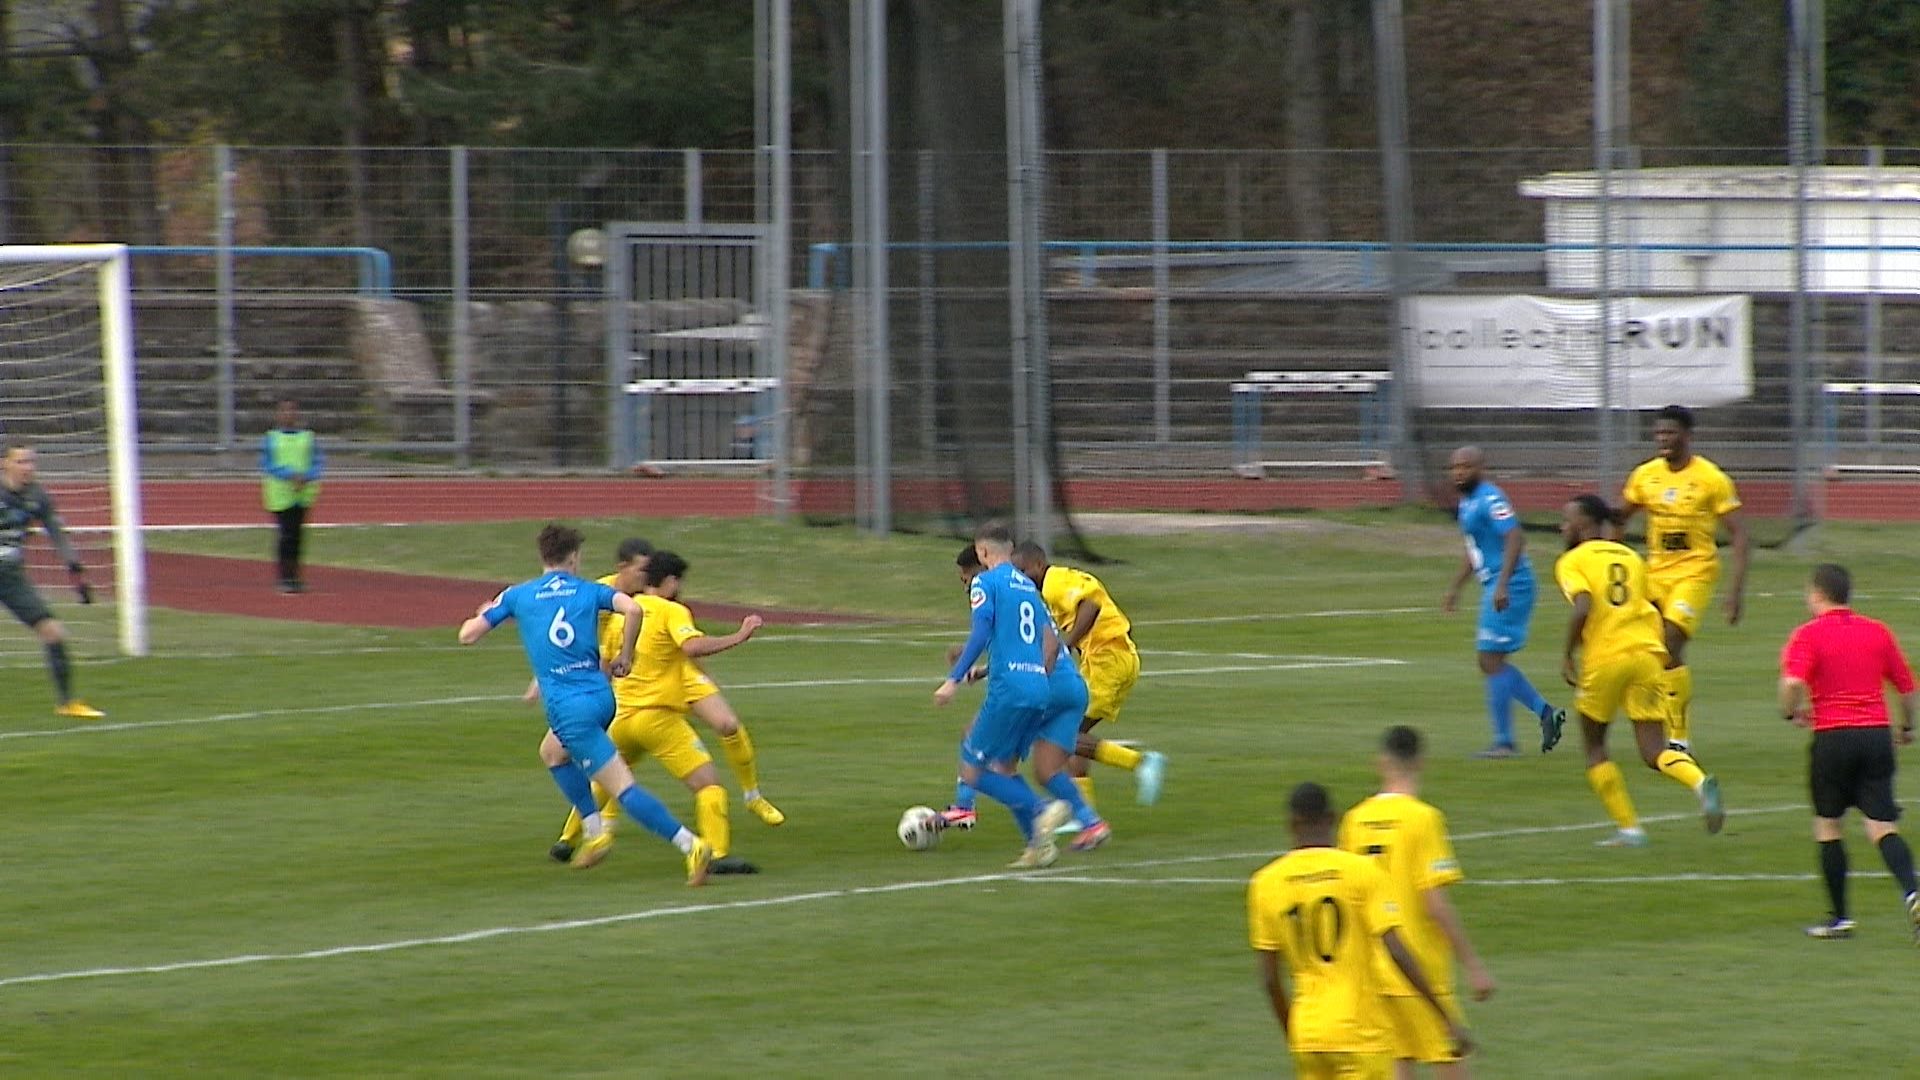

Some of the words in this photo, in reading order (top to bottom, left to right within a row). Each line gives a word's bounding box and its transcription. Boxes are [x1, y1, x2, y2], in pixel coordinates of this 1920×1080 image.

[1606, 563, 1629, 606] 8
[548, 605, 575, 649] 6
[1019, 600, 1036, 645] 8
[1282, 896, 1342, 963] 10
